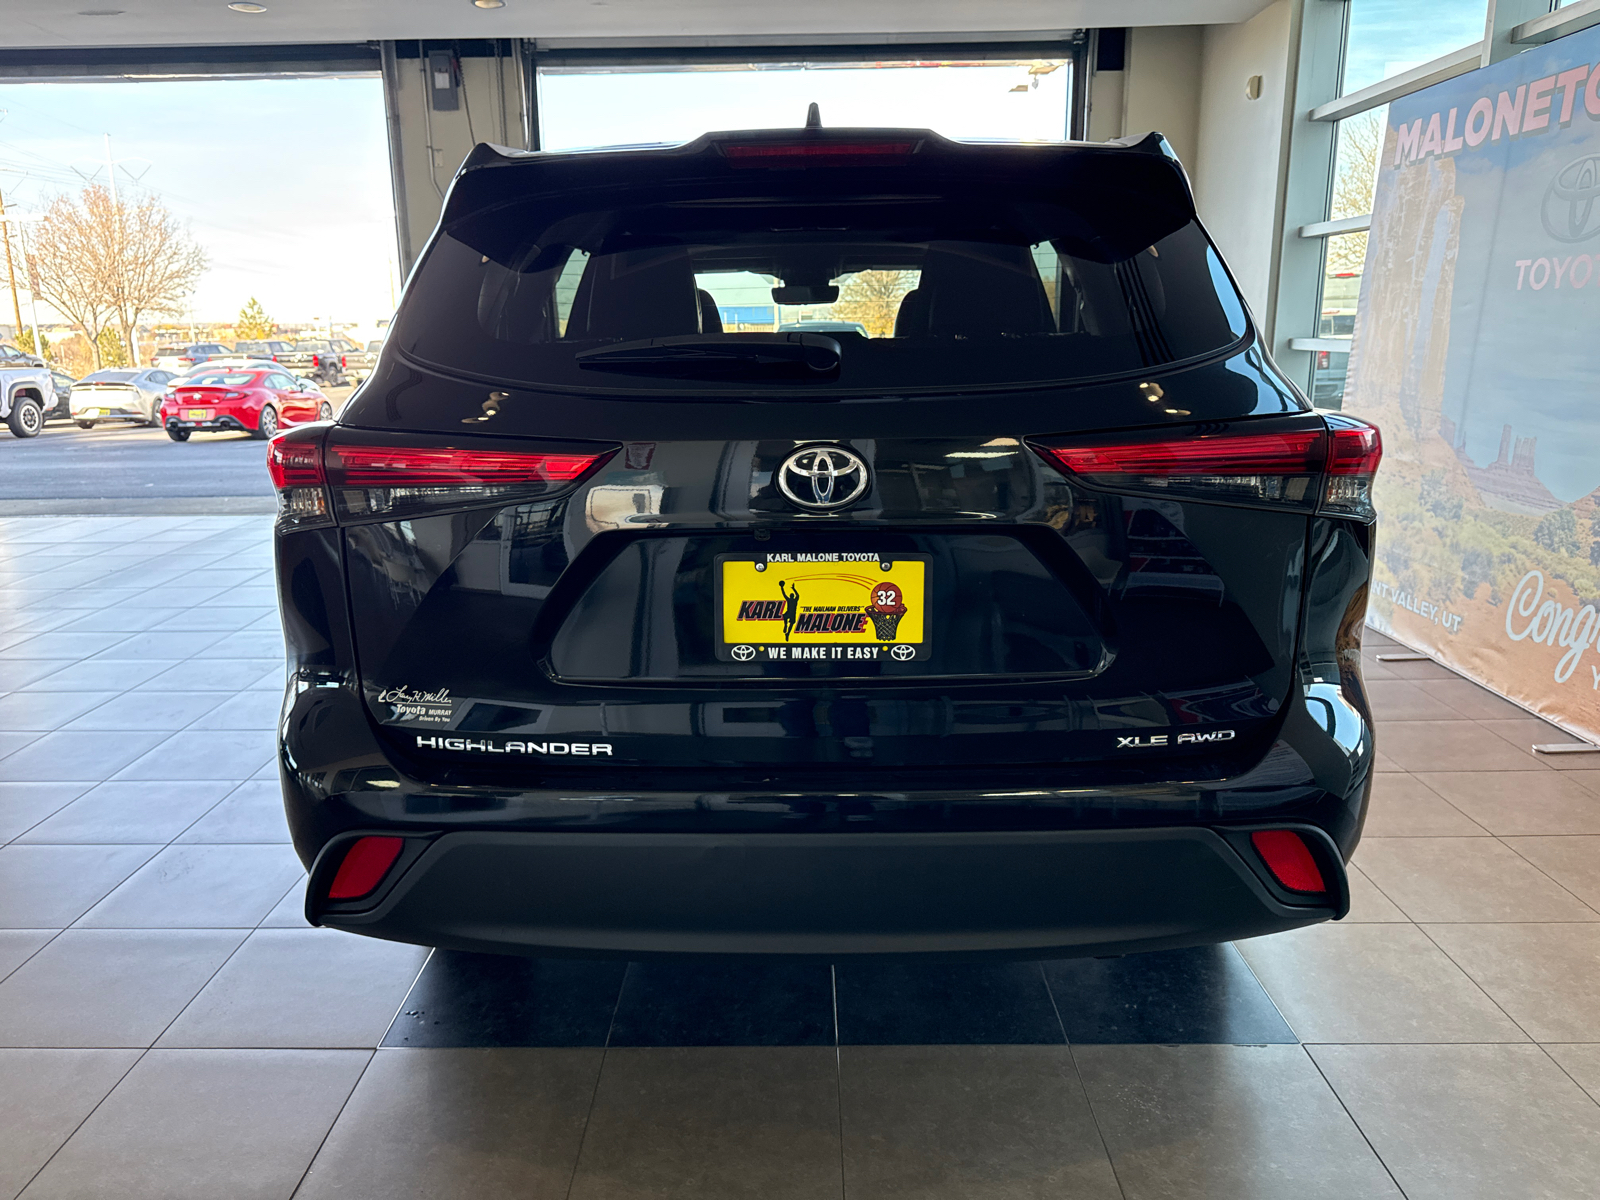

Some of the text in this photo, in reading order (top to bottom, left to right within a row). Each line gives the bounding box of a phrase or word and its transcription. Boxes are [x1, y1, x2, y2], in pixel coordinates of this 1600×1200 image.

[767, 553, 880, 562] KARL MALONE TOYOTA
[877, 590, 896, 606] 32
[737, 600, 786, 621] KARL
[794, 613, 868, 633] MALONE
[1441, 610, 1462, 632] UT
[768, 647, 879, 659] WE MAKE IT EASY
[396, 704, 426, 715] Toyota
[416, 735, 613, 756] HIGHLANDER
[1117, 729, 1236, 748] XLE AWD
